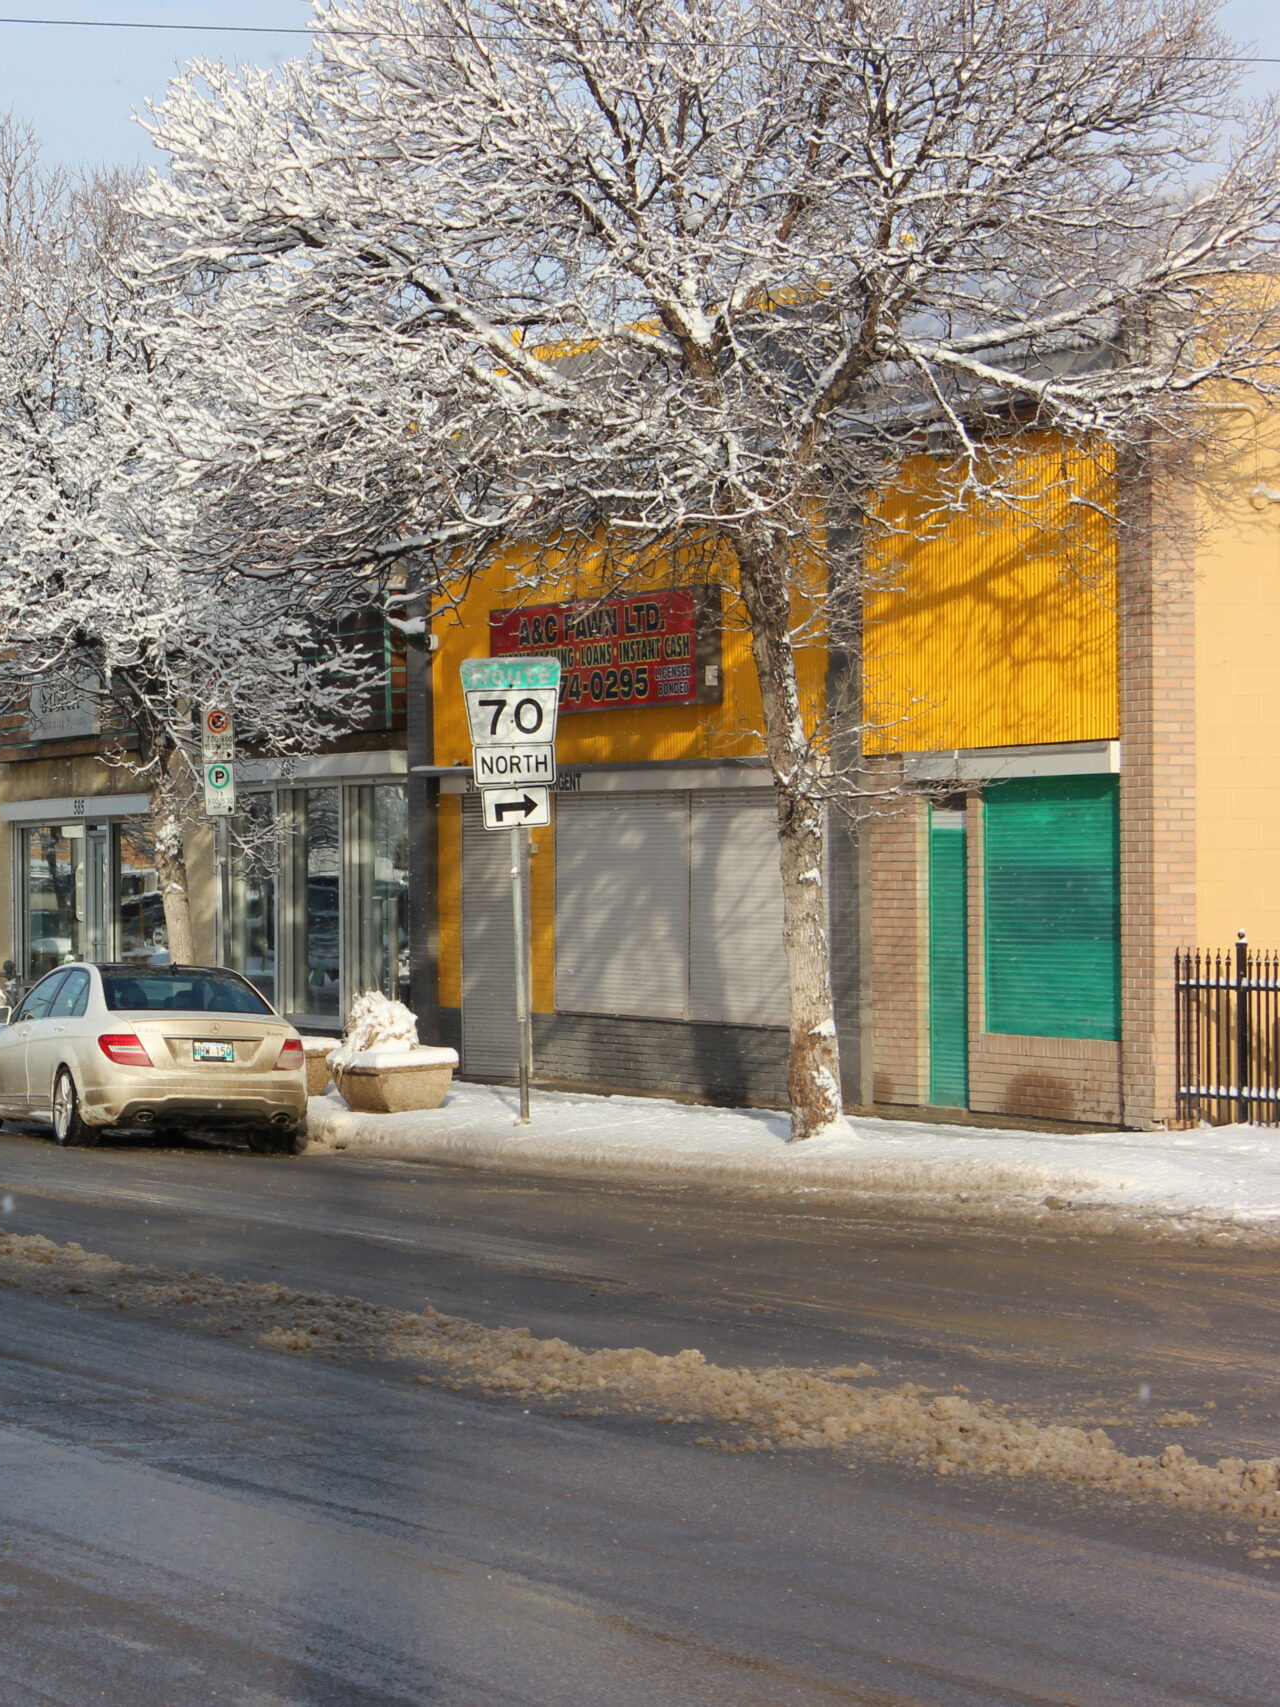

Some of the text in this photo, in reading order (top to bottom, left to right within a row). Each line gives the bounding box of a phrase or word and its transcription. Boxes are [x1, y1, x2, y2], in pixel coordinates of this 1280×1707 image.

[518, 614, 558, 648] A&C
[564, 602, 618, 642] PAWN
[581, 642, 612, 667] LOANS
[619, 636, 661, 665] INSTANT
[664, 633, 690, 659] CASH
[655, 664, 691, 680] LICENSED
[658, 681, 689, 697] BONDED
[478, 698, 543, 735] 70
[481, 754, 548, 775] NORTH
[215, 770, 224, 783] P
[73, 800, 85, 815] 585
